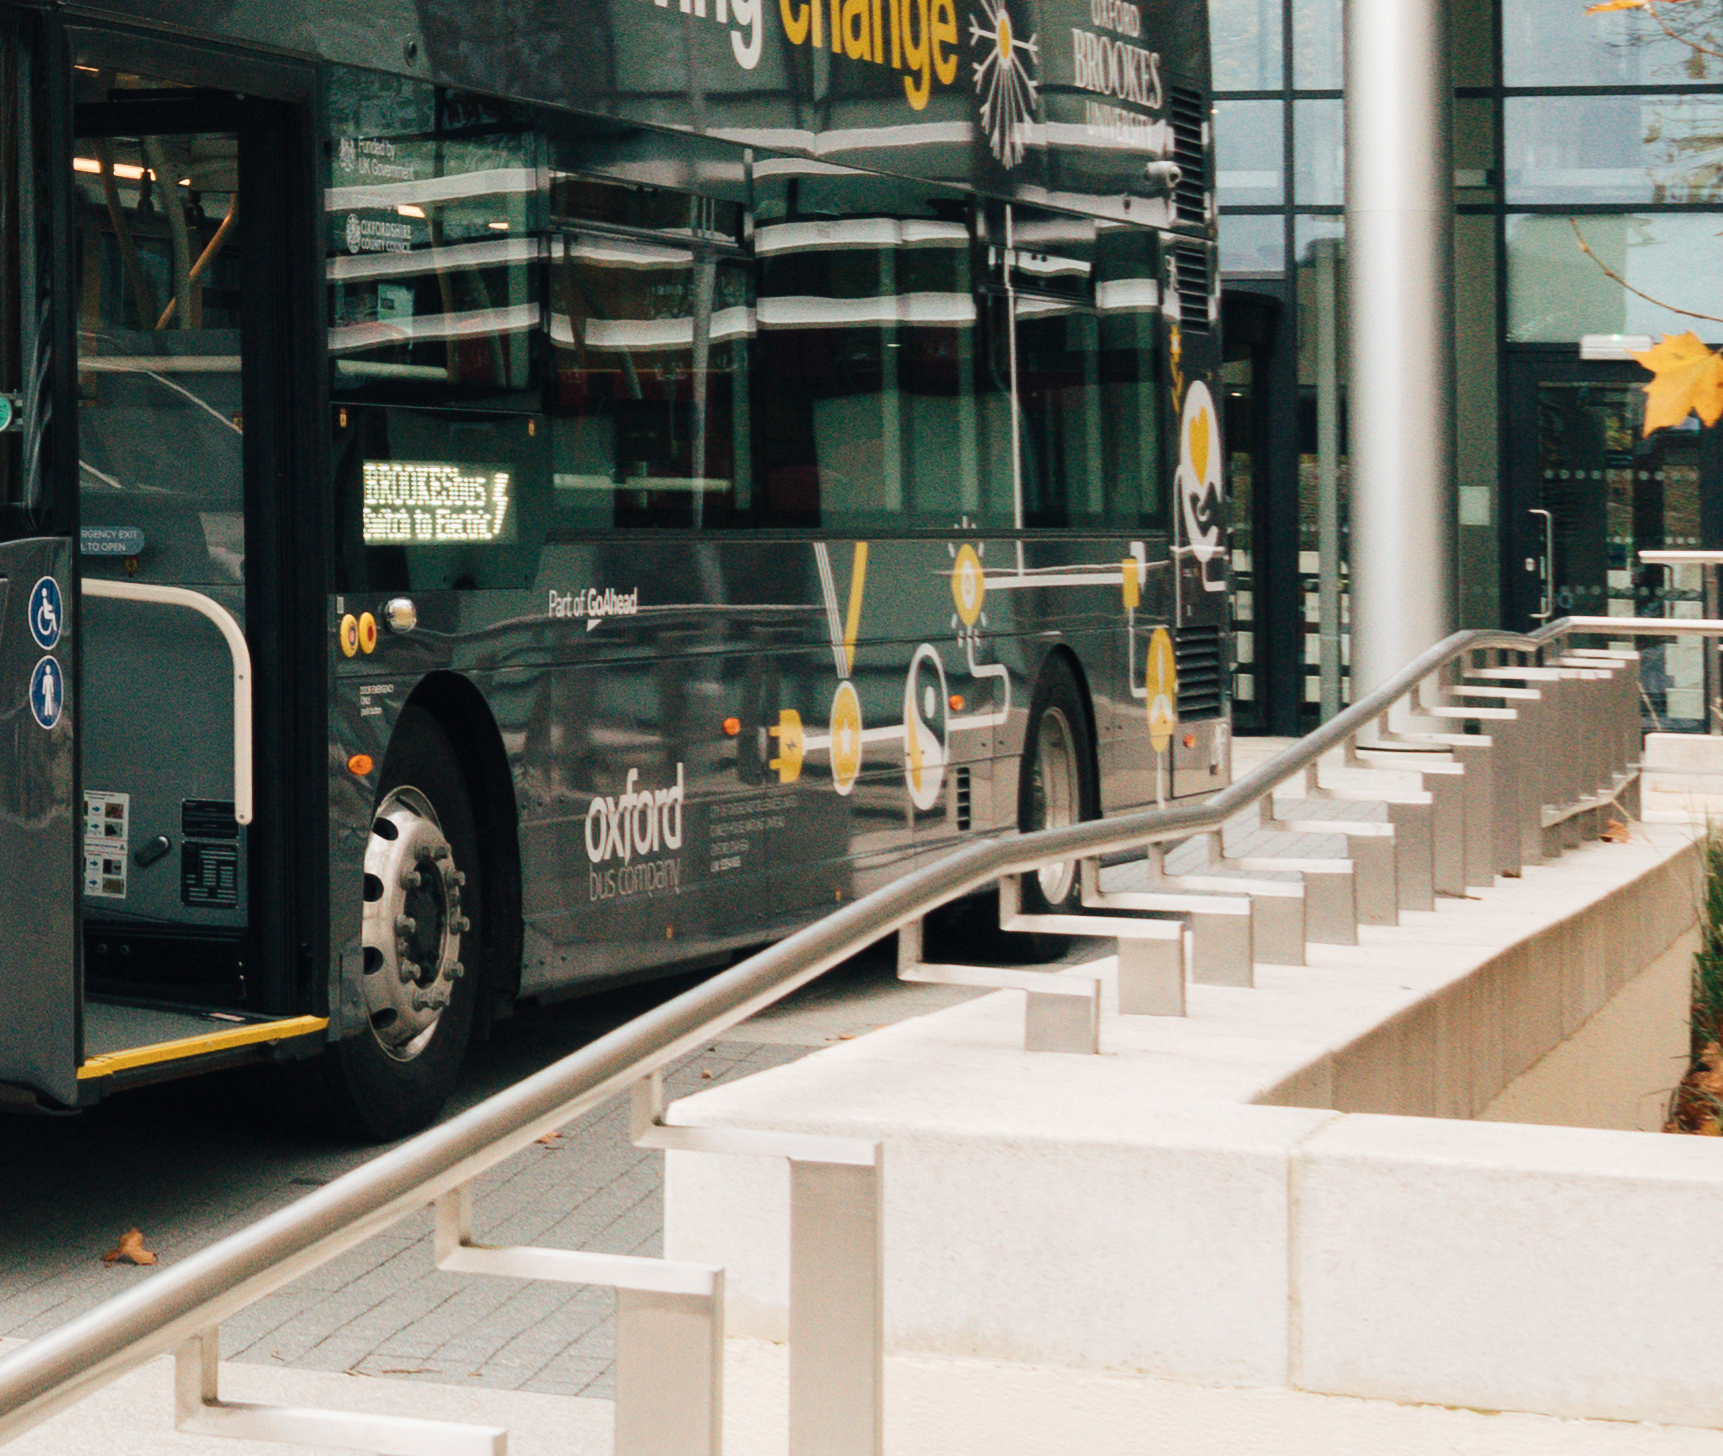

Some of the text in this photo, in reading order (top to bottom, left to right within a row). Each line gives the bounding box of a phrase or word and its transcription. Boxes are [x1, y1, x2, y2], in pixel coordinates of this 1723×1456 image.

[1072, 28, 1163, 109] BROOKES
[549, 590, 573, 618] Part
[573, 589, 586, 617] of
[585, 762, 684, 866] oxford
[589, 857, 682, 901] bus company
